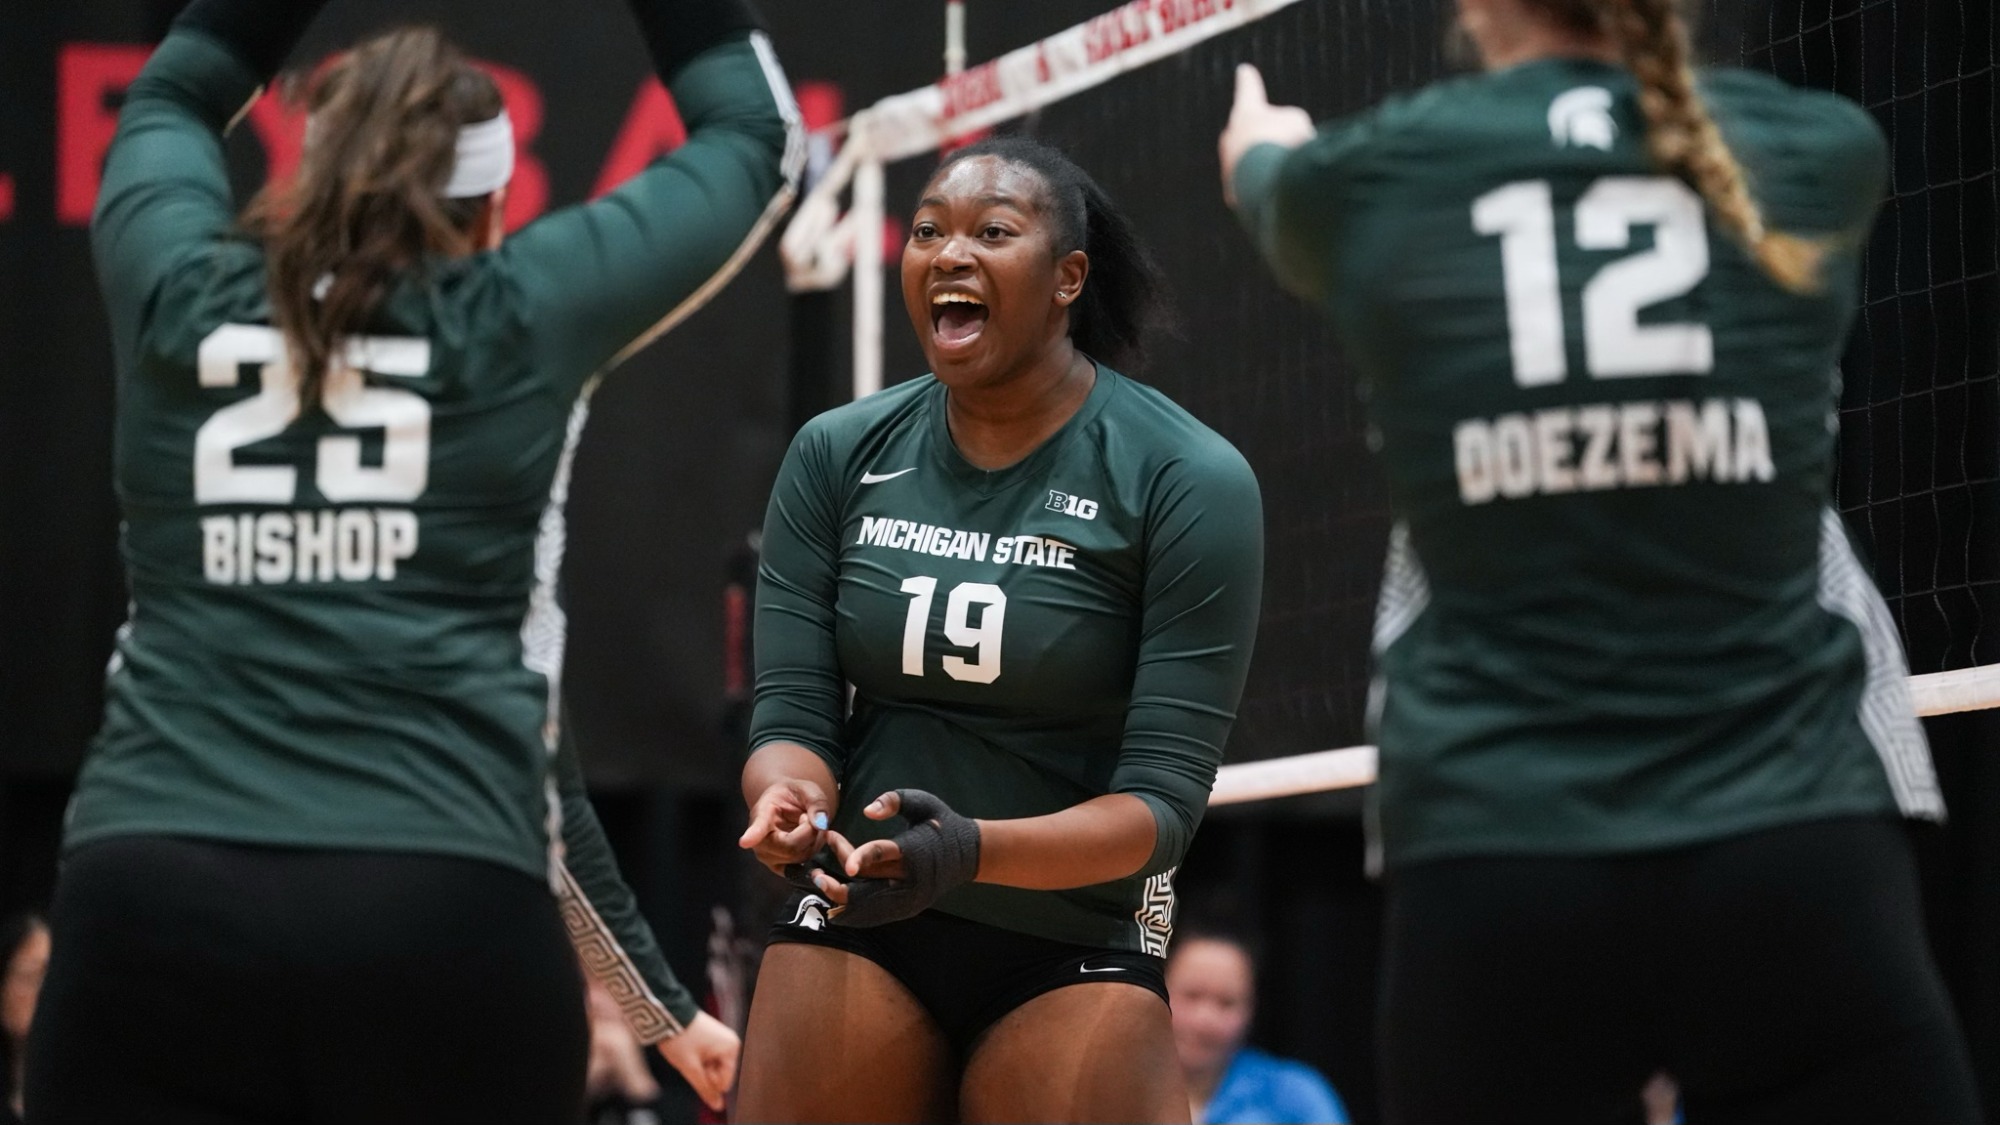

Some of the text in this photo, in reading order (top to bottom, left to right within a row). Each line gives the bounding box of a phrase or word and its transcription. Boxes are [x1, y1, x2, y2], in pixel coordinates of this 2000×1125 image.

[1471, 176, 1714, 387] 12
[194, 321, 432, 504] 25
[1453, 397, 1776, 505] DOEZEMA
[202, 509, 418, 584] BISHOP
[856, 516, 1077, 570] MICHIGAN STATE
[900, 576, 1007, 684] 19
